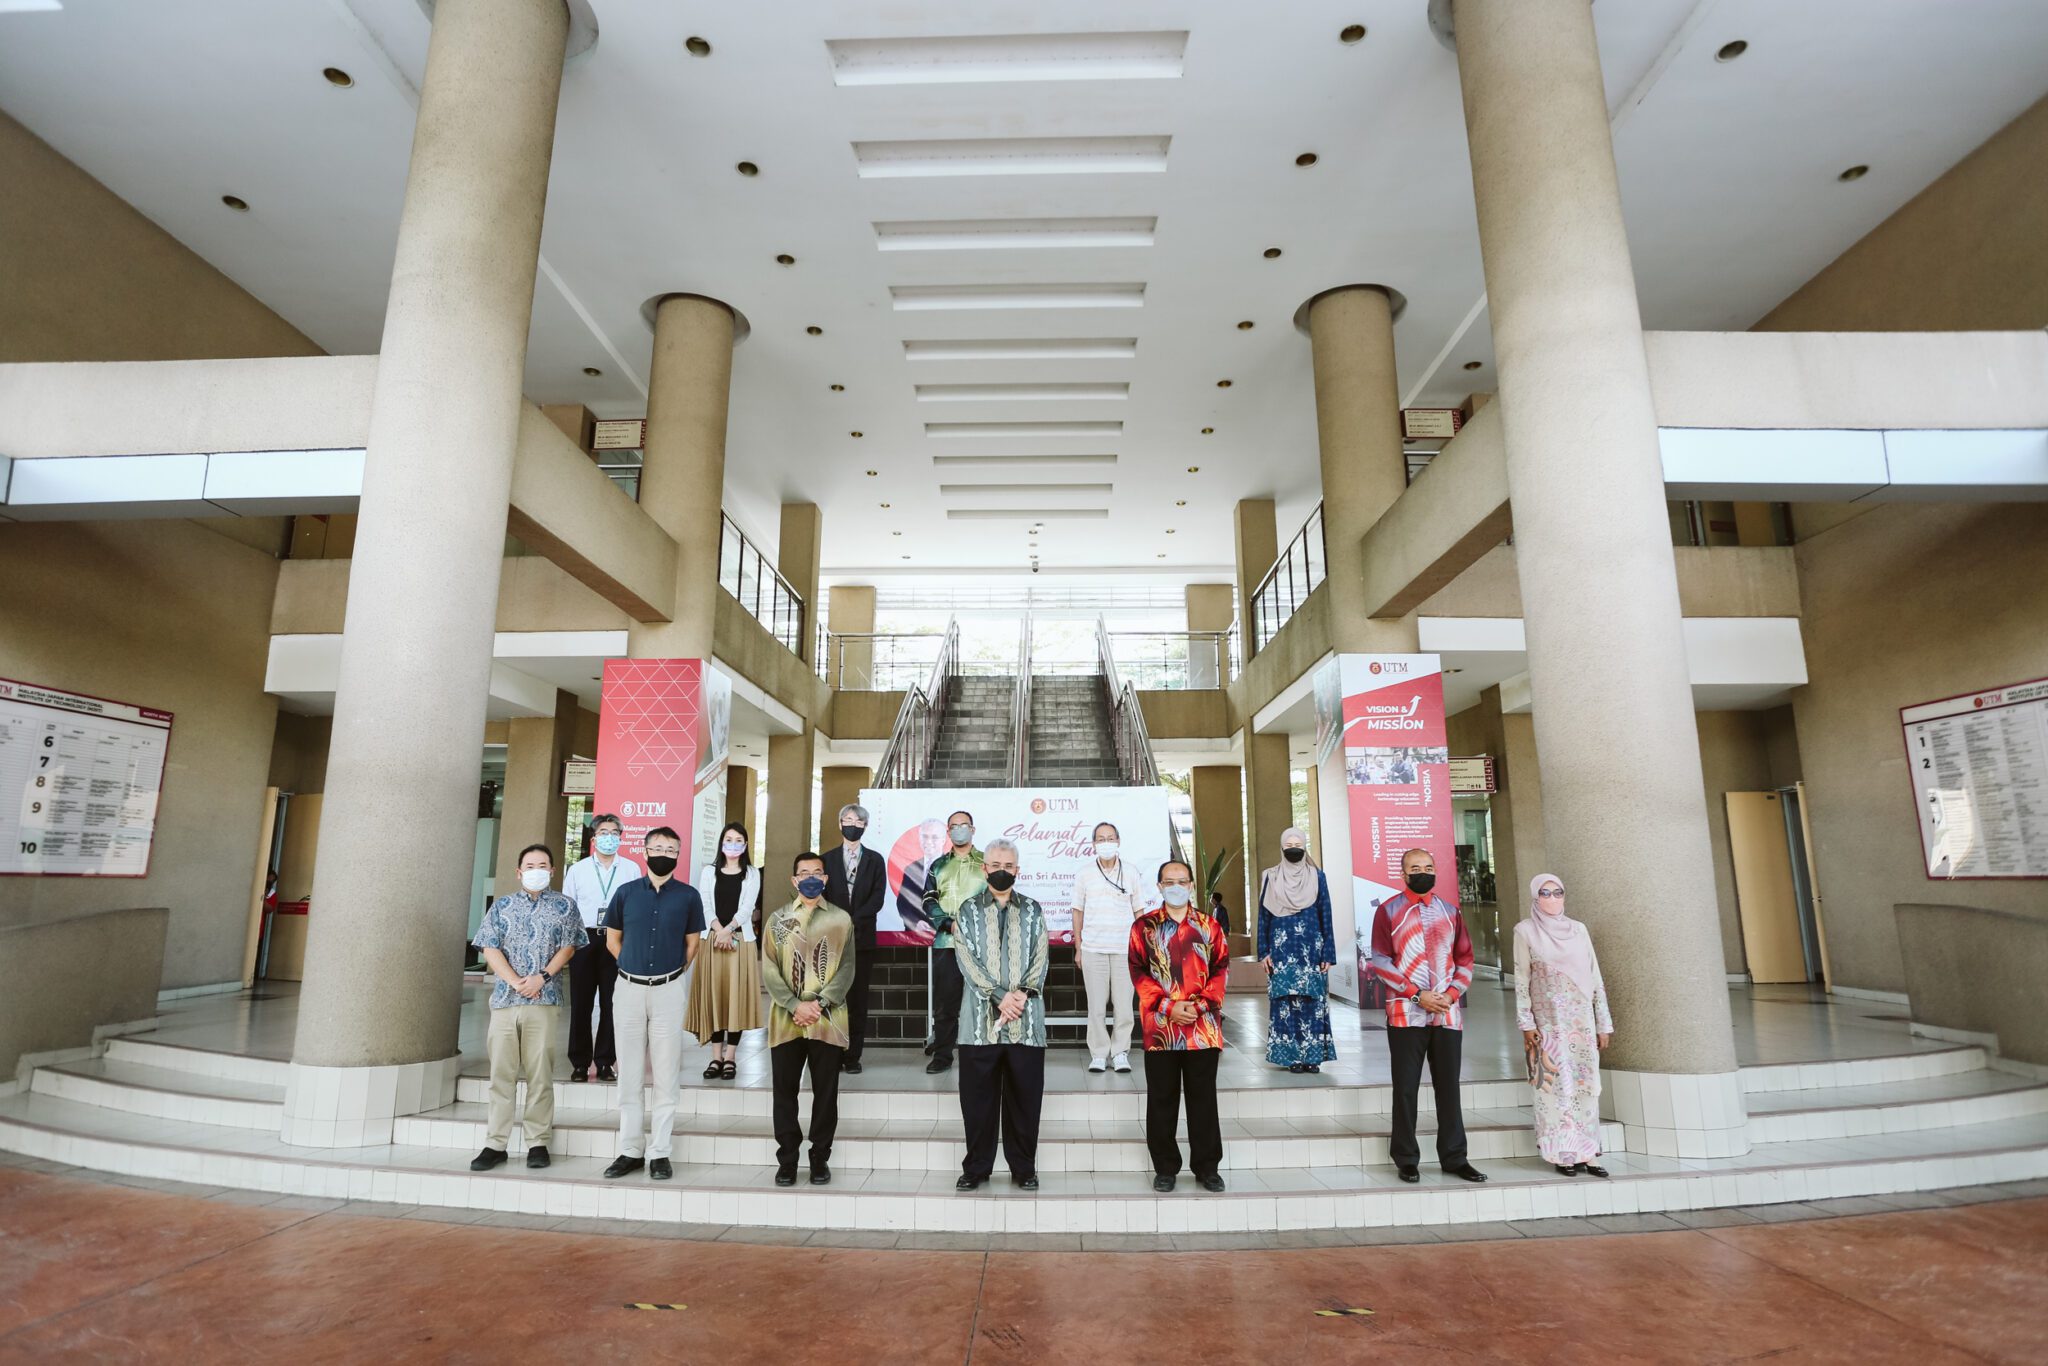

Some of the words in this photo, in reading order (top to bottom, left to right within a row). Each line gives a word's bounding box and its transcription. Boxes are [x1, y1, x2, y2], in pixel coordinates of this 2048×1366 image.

[1383, 662, 1408, 673] UTM
[0, 684, 13, 696] TM
[1983, 693, 2002, 706] UTM
[1366, 705, 1399, 714] VISION
[1401, 705, 1408, 713] &
[1367, 716, 1425, 730] MISSION
[44, 736, 54, 748] 6
[1920, 736, 1926, 748] 1
[40, 756, 50, 768] 7
[1922, 758, 1931, 769] 2
[36, 775, 46, 788] 8
[32, 801, 42, 814] 9
[636, 802, 667, 815] UTM
[1048, 799, 1079, 811] UTM
[1003, 820, 1091, 842] Selamat
[20, 842, 37, 854] 10
[1016, 872, 1033, 880] Tan
[1036, 871, 1048, 880] Sri
